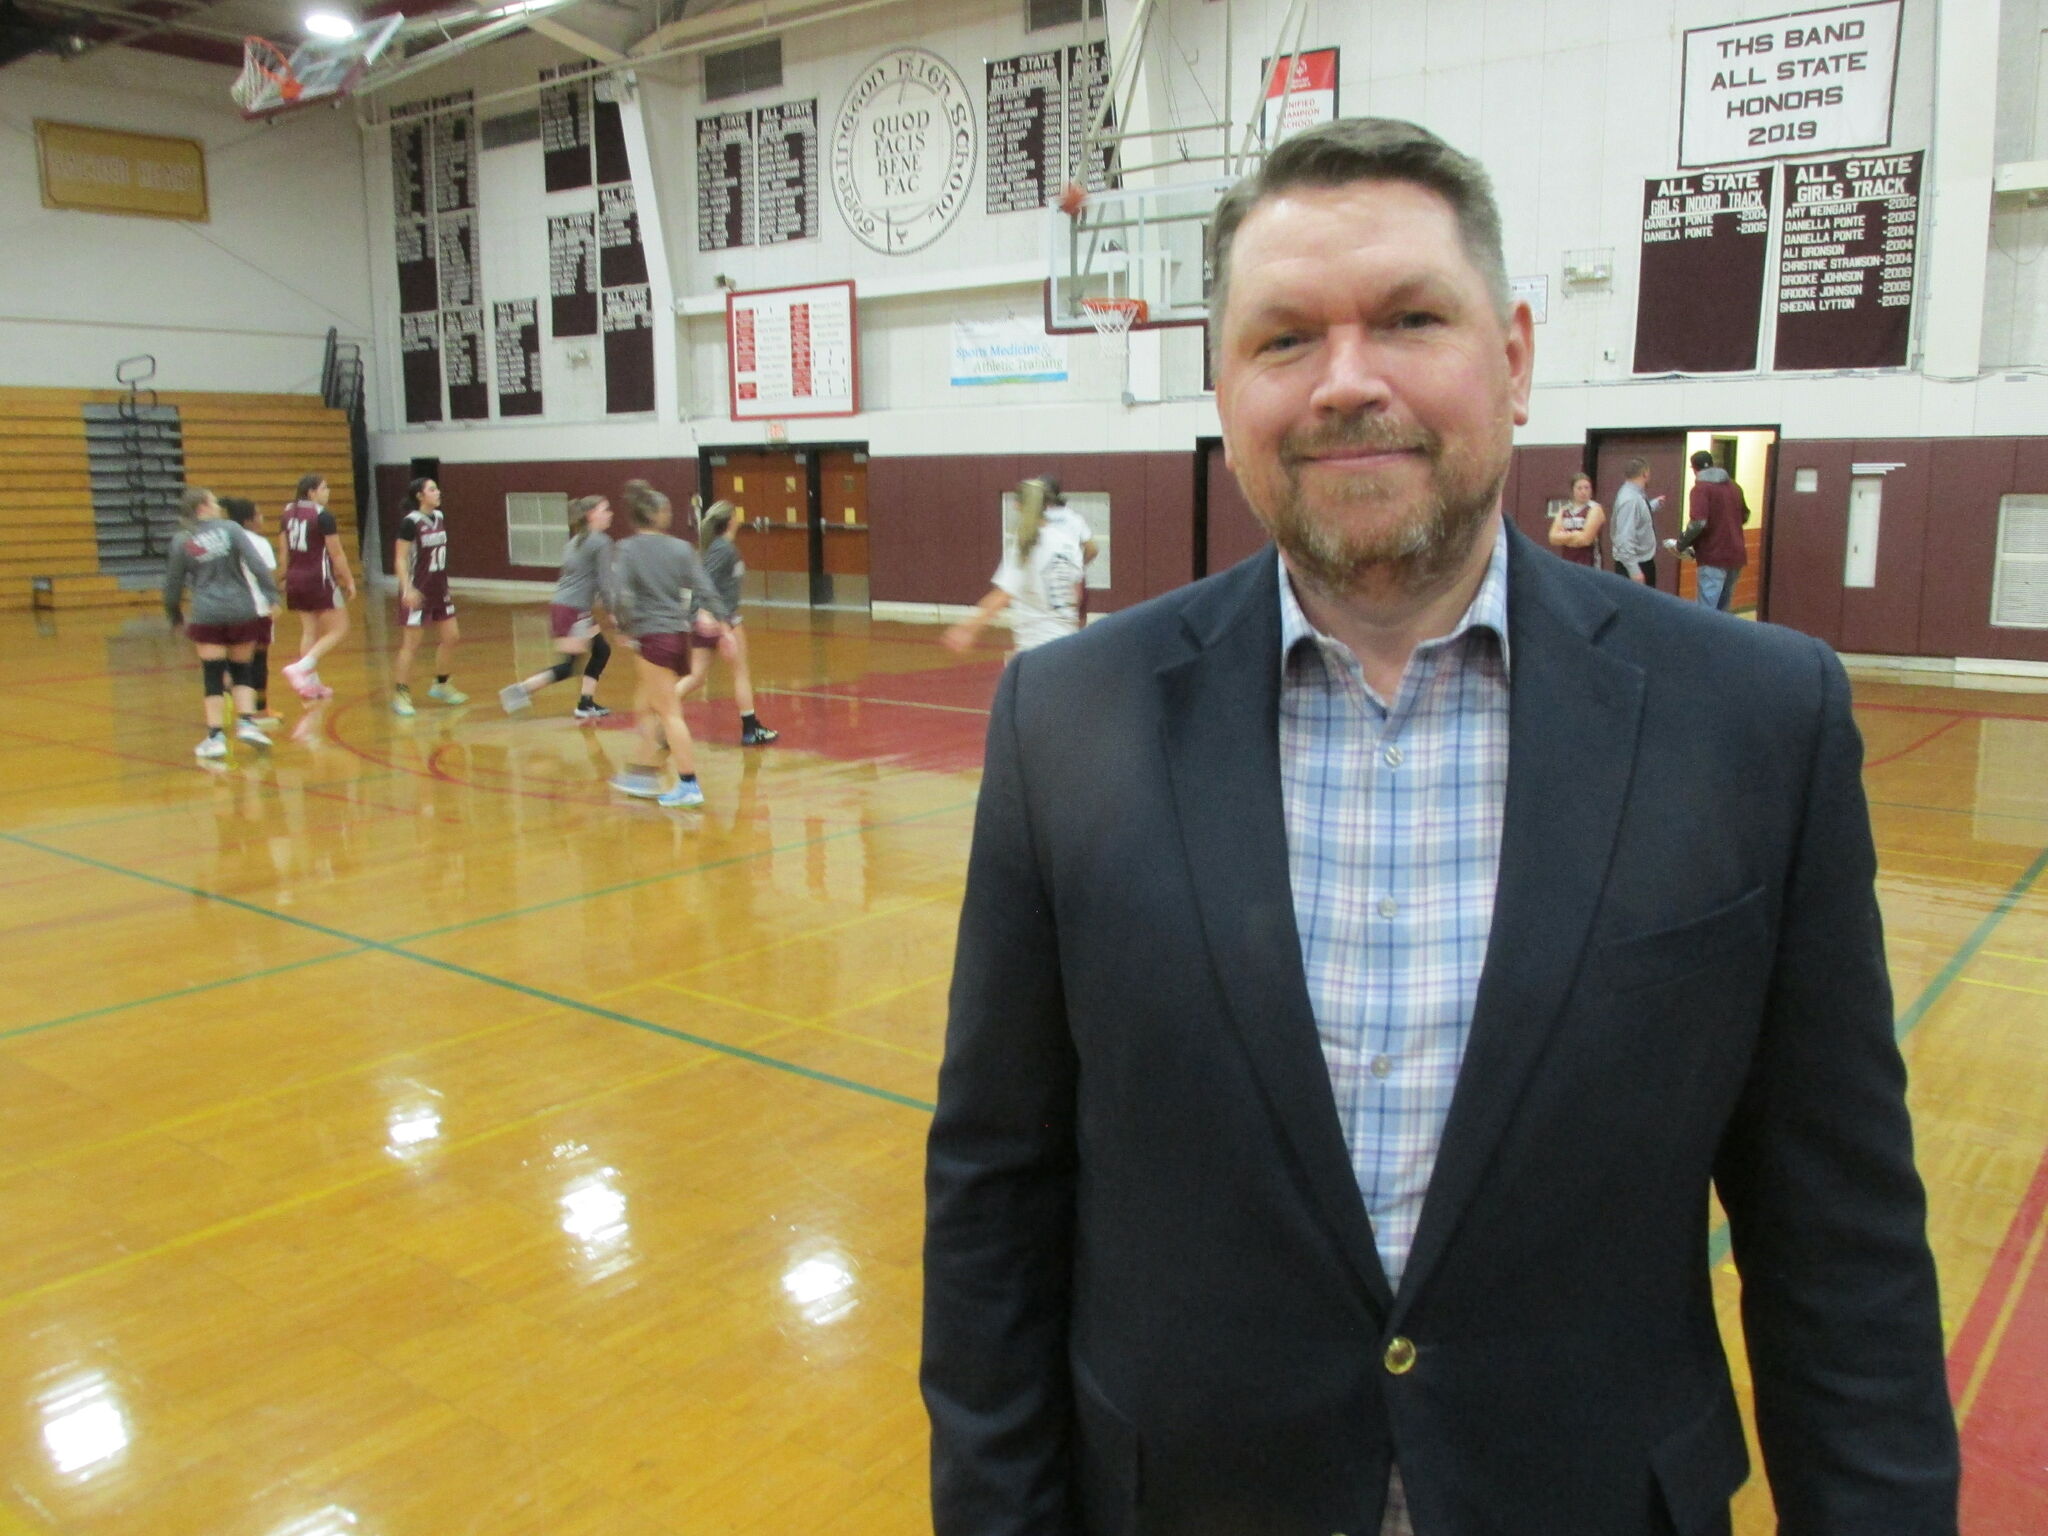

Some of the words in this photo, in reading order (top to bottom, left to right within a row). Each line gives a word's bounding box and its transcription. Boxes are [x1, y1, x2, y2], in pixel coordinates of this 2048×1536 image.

[1717, 34, 1774, 59] THS
[1784, 20, 1865, 48] BAND
[993, 62, 1015, 77] ALL
[1019, 54, 1056, 72] STATE
[1710, 68, 1767, 91] ALL
[1776, 51, 1868, 80] STATE
[1286, 99, 1315, 110] NIFIED
[1726, 86, 1844, 119] HONORS
[873, 110, 930, 137] QUOD
[1748, 121, 1817, 147] 2019
[877, 153, 922, 177] BENE
[1795, 164, 1836, 185] ALL
[1845, 156, 1913, 179] STATE
[884, 175, 920, 196] FAC
[1657, 179, 1694, 197] ALL
[1702, 171, 1760, 192] STATE
[1797, 182, 1844, 202] GIRLS
[1852, 177, 1906, 198] TRACK
[1651, 198, 1680, 216] GIRLS
[1685, 193, 1721, 213] INDOOR
[1728, 190, 1763, 209] TRACK
[1785, 207, 1806, 219] AMY
[1644, 229, 1680, 243] DANIELA
[1685, 225, 1714, 239] PONTE
[1833, 215, 1866, 229] PONTE
[1833, 228, 1865, 242] PONTE
[990, 344, 1040, 356] Medicine
